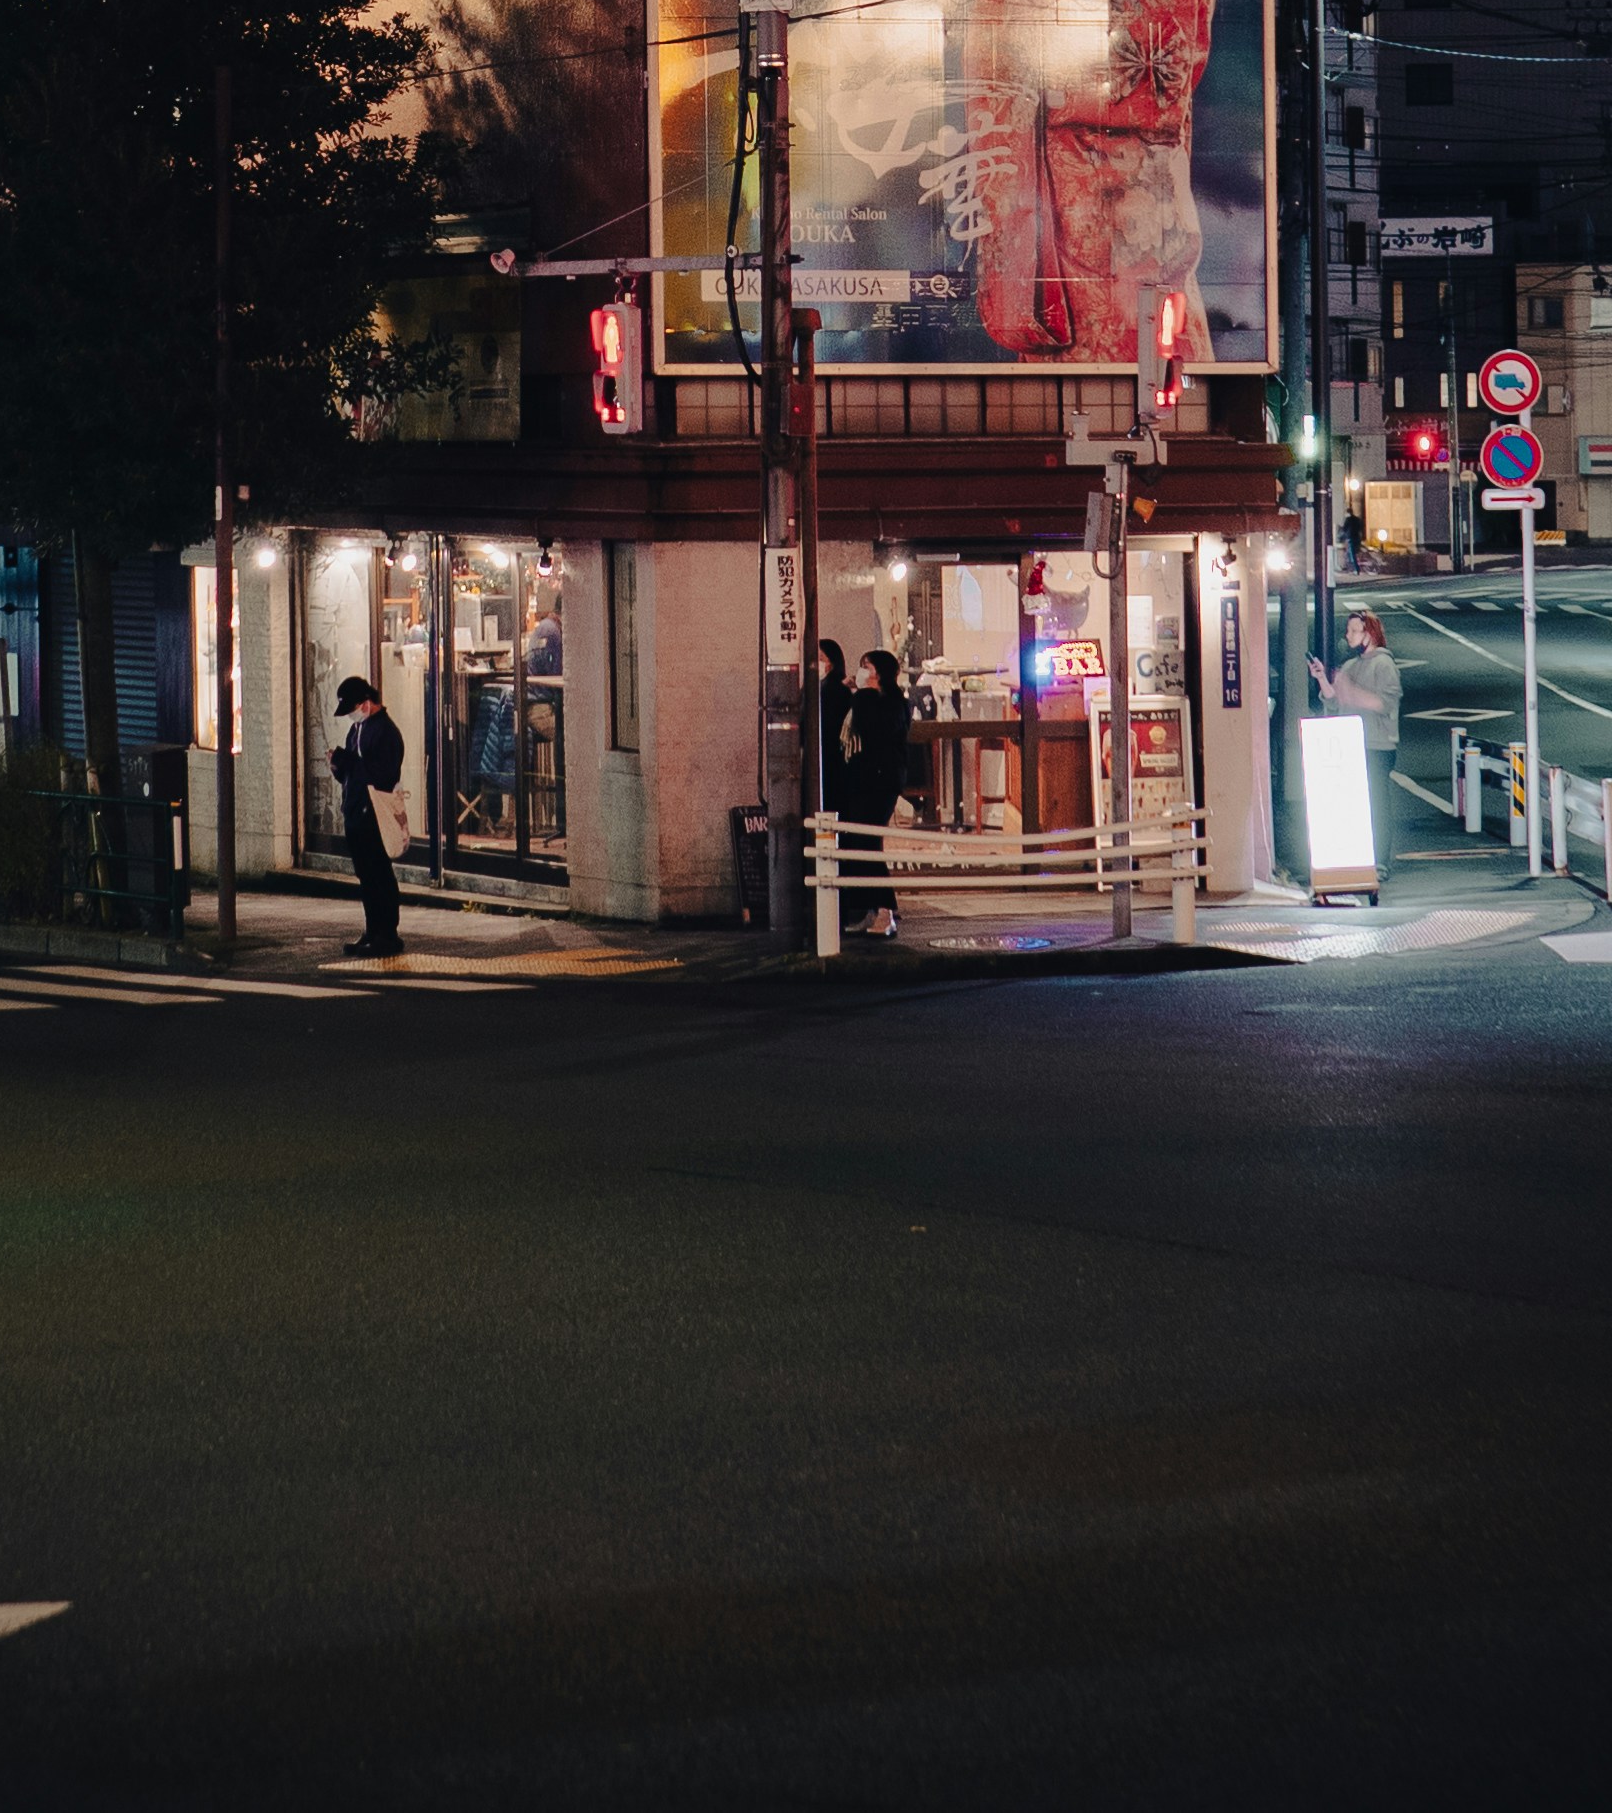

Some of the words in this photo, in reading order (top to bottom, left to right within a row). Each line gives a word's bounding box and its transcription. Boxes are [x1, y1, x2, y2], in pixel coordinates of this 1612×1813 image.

[806, 207, 848, 220] Rental
[851, 207, 887, 220] Salon
[789, 224, 856, 242] OUKA
[791, 276, 884, 296] ASAKUSA
[777, 555, 797, 643] 防犯カメラ作動中
[1052, 656, 1104, 676] BAR
[1225, 688, 1239, 703] 16
[744, 816, 769, 834] BAR
